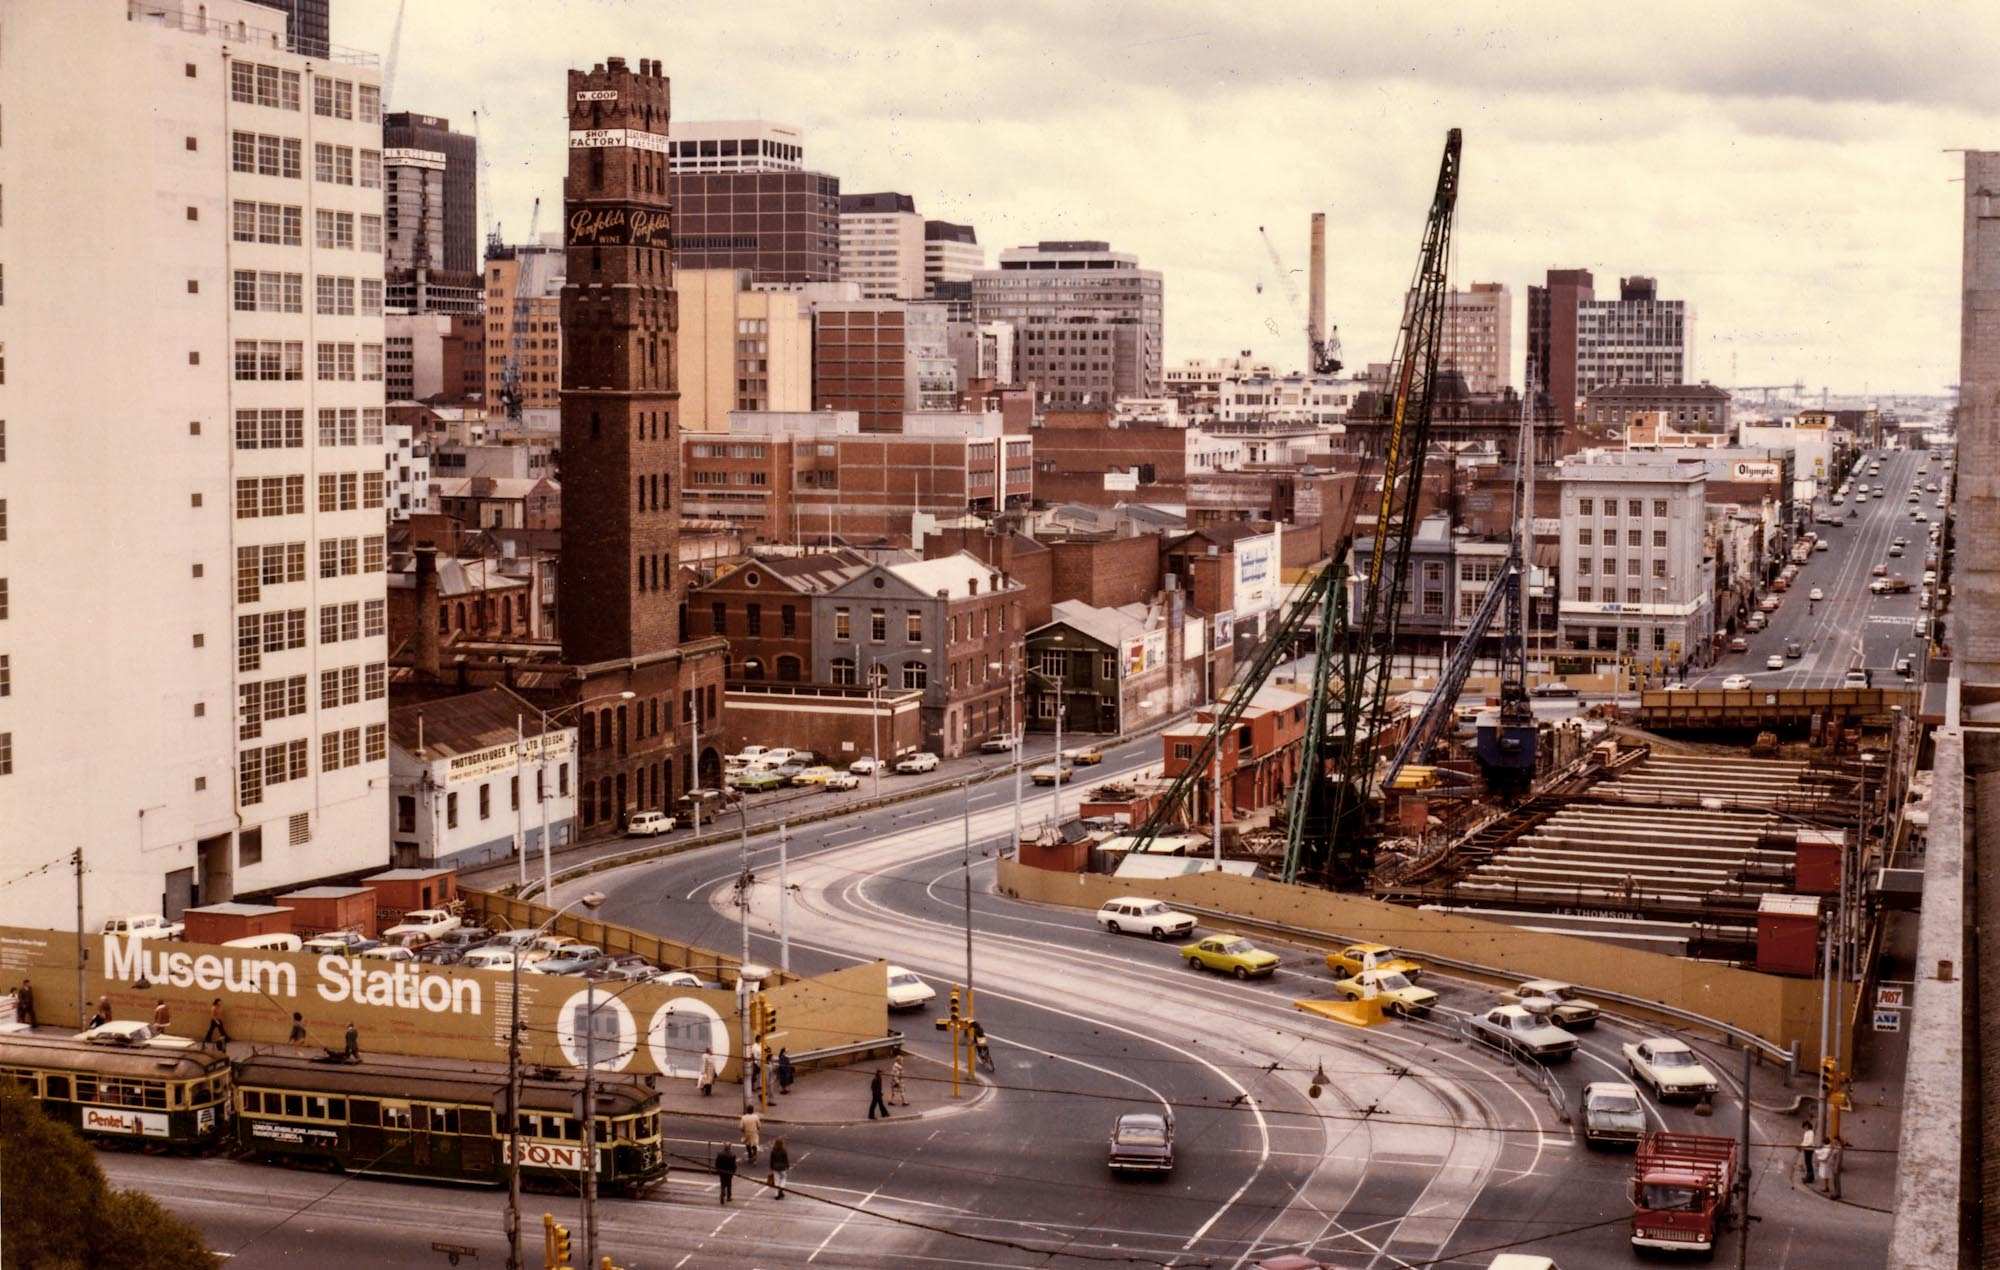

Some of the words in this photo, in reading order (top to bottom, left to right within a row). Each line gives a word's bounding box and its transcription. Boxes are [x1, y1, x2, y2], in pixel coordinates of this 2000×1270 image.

[571, 137, 622, 146] FACTORY
[1739, 464, 1774, 477] Olympic
[450, 747, 506, 769] PHOTOGRAVURES
[526, 739, 538, 751] LTD
[104, 934, 297, 997] Museum
[317, 954, 481, 1015] Station
[1880, 990, 1901, 1003] POST
[88, 1110, 124, 1128] Pentel
